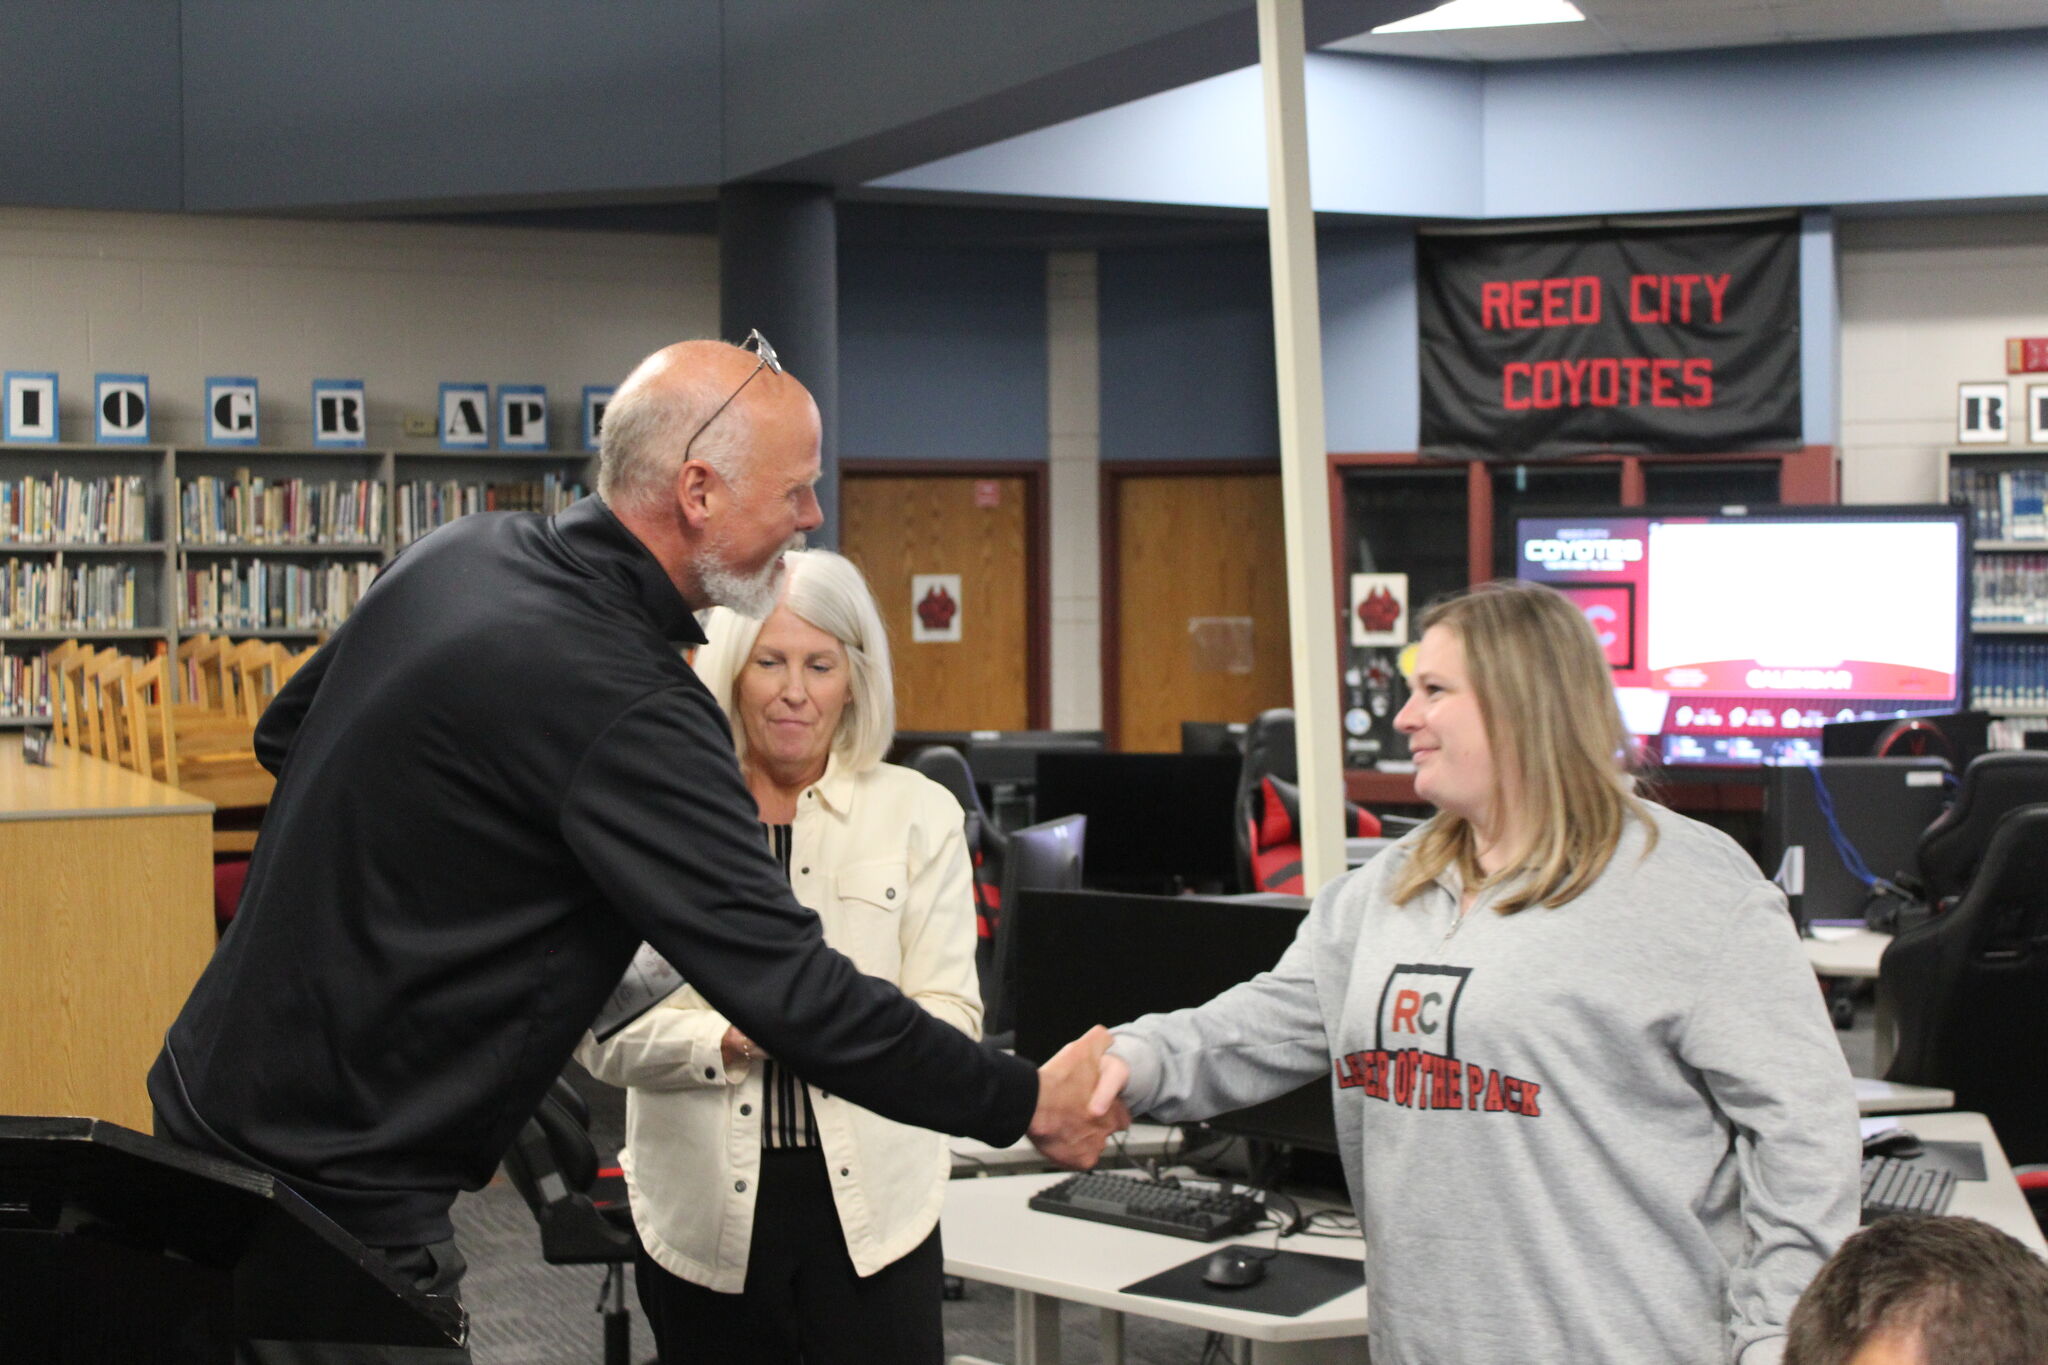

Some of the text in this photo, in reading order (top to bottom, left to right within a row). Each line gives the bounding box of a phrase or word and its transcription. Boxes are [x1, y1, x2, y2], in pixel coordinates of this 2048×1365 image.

[1480, 273, 1732, 330] REED CITY
[1503, 357, 1714, 410] COYOTES
[102, 390, 146, 428] O
[213, 392, 254, 430] G
[320, 397, 361, 434] R
[448, 398, 486, 436] A
[506, 401, 545, 437] P
[1966, 397, 2003, 430] R
[1391, 989, 1442, 1035] RC
[1394, 1047, 1419, 1109] OF
[1418, 1050, 1463, 1111] THE
[1466, 1062, 1542, 1118] PACK
